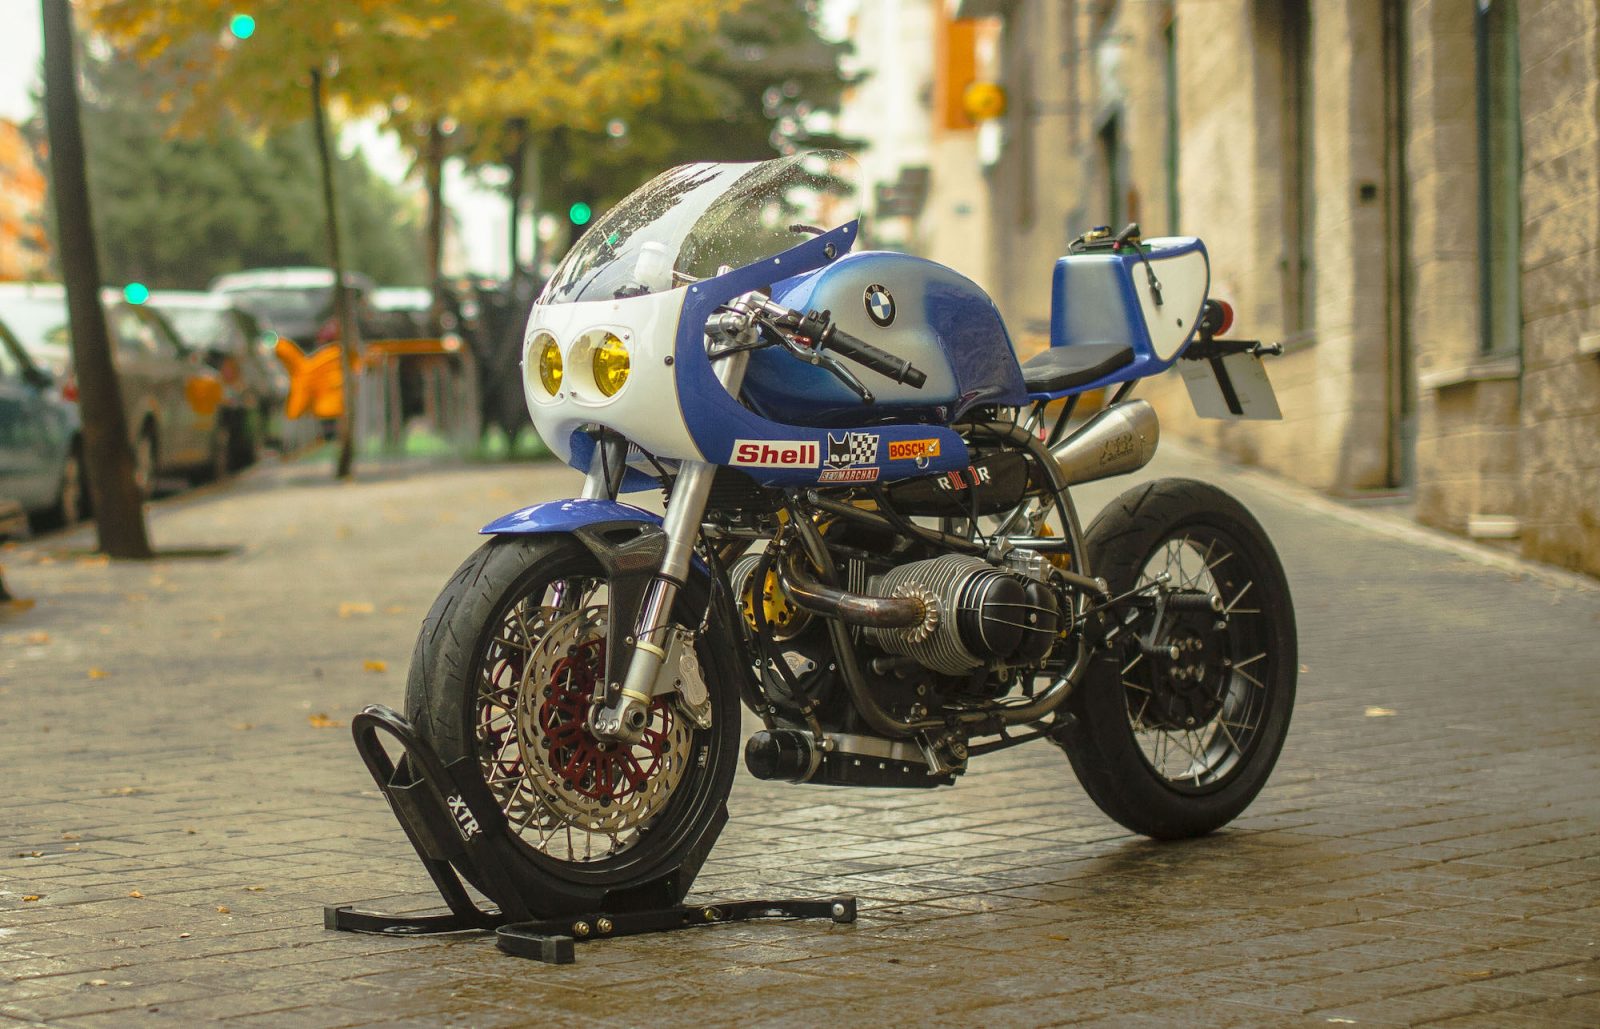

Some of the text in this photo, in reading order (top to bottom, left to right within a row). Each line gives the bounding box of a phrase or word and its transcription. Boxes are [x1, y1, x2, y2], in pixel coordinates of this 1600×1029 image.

[865, 284, 891, 301] BMW
[736, 443, 815, 464] Shell
[890, 442, 926, 458] BOSCH
[447, 794, 480, 837] XTR
